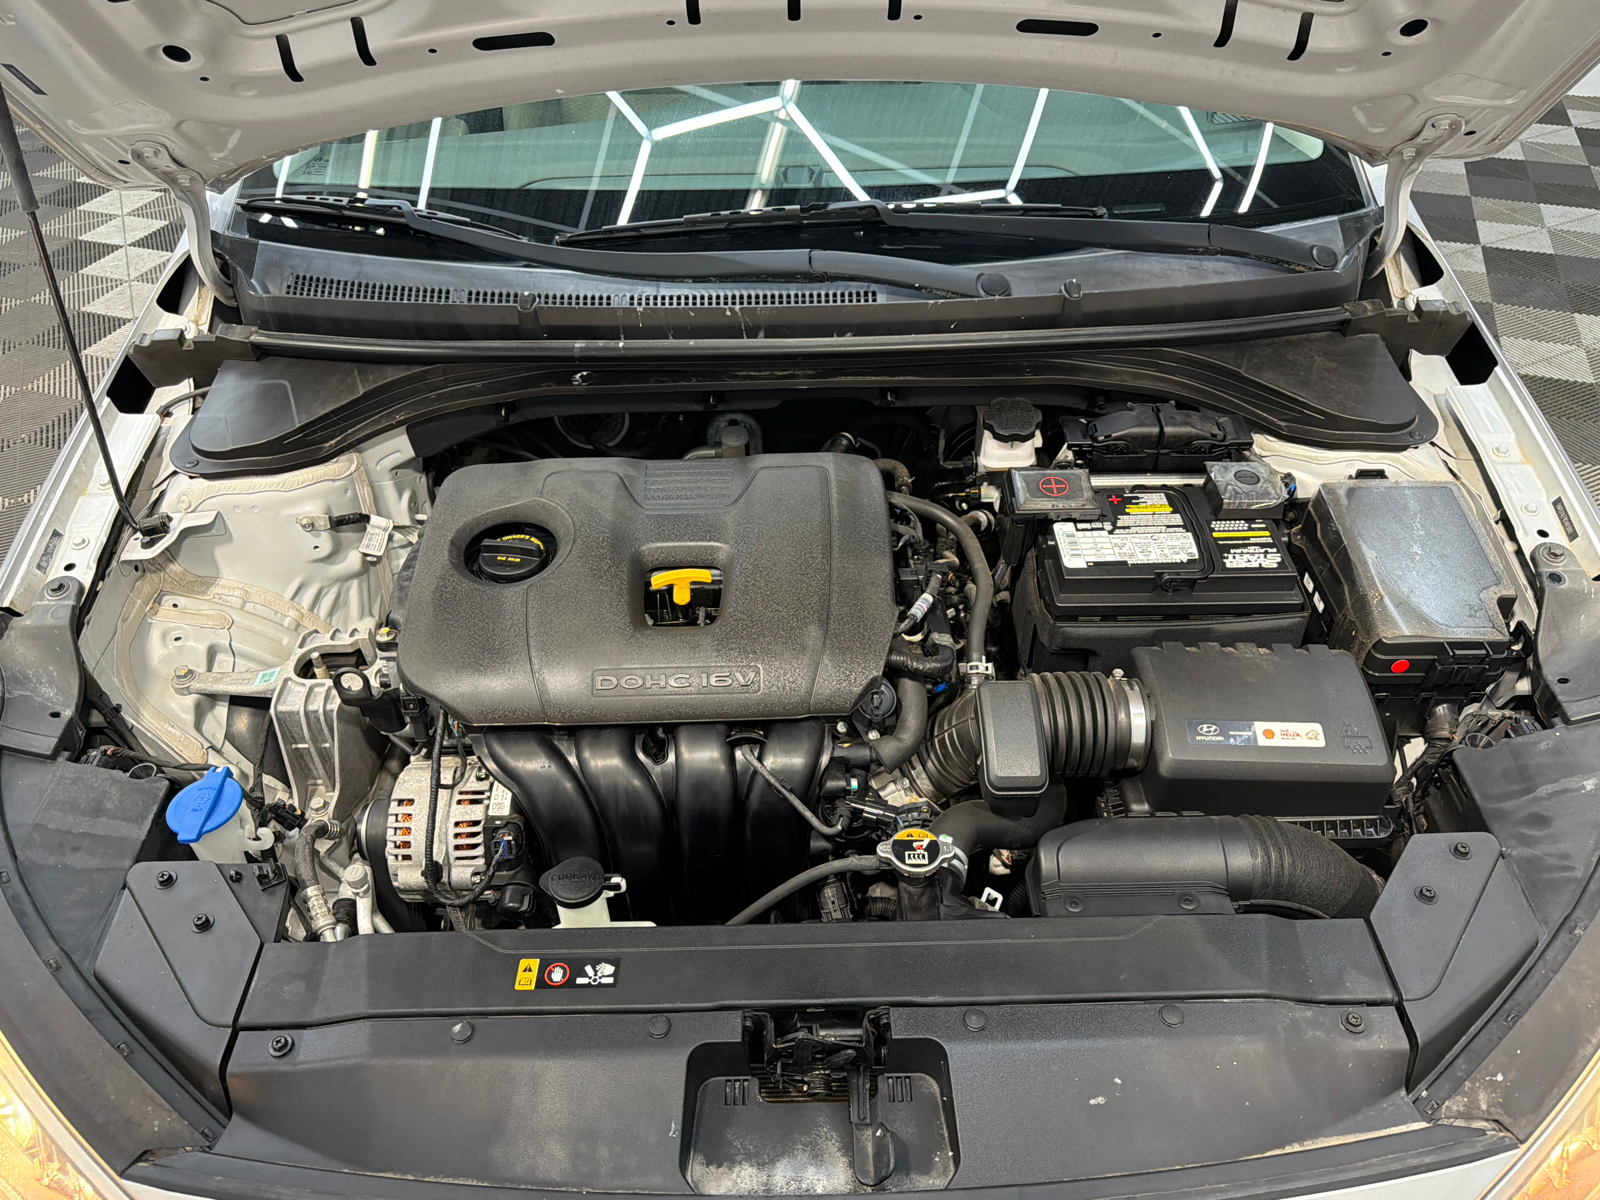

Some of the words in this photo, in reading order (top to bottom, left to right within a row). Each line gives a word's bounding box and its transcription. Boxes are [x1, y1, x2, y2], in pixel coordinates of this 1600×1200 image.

[595, 673, 691, 691] DOHC
[701, 671, 757, 688] 16V
[550, 873, 603, 882] COOLANT
